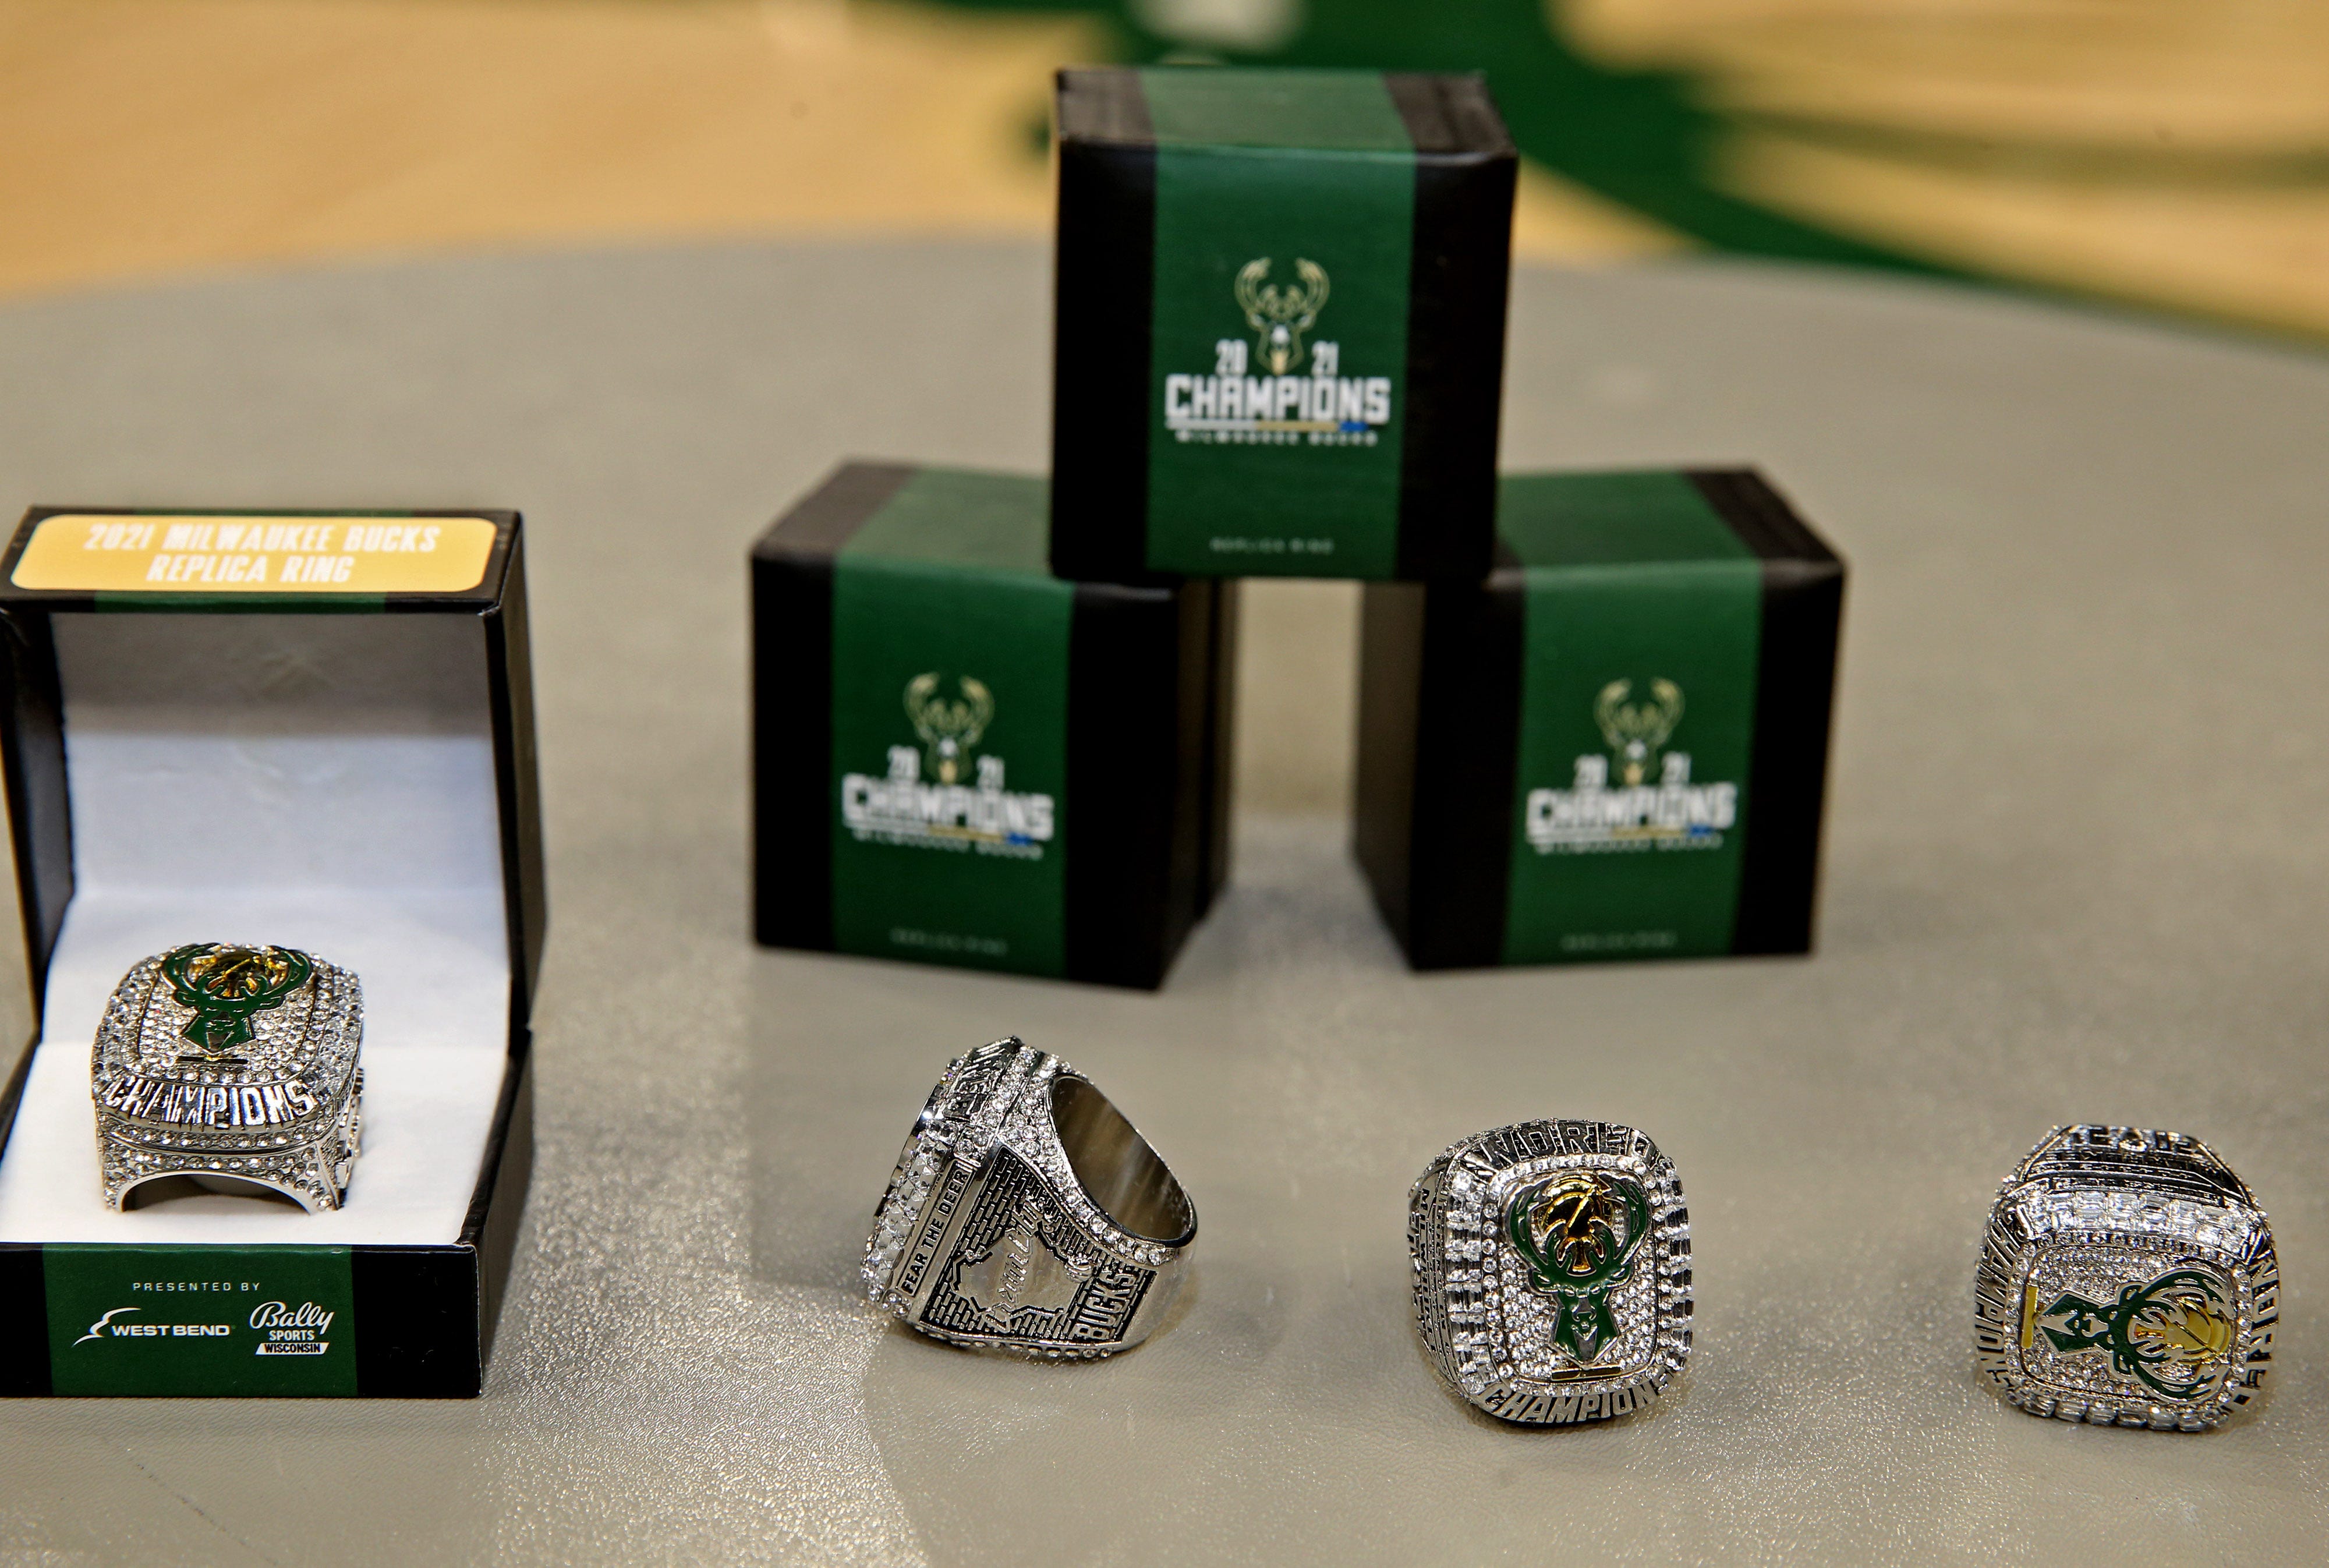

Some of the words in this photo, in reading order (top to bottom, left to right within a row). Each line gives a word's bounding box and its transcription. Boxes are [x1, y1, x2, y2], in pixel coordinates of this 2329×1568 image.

[1216, 339, 1248, 376] 20
[1311, 341, 1339, 376] 21
[1166, 374, 1392, 424] CHAMPIONS
[84, 523, 154, 551] 2021
[162, 525, 331, 551] MILWAUKEE
[342, 526, 441, 552] BUCKS
[146, 555, 266, 582] REPLICA
[280, 556, 355, 583] RING
[104, 1074, 318, 1127] CHAMPIONS
[901, 1252, 929, 1294] FEAR
[921, 1217, 944, 1250] THE
[937, 1169, 969, 1217] DEER
[133, 1282, 232, 1291] PRESENTED
[241, 1282, 260, 1291] BY
[1072, 1268, 1137, 1340] BUCKS
[1976, 1203, 2034, 1389] CHAMPIONS
[112, 1325, 170, 1336] WEST
[173, 1325, 230, 1336] BEND
[249, 1301, 335, 1335] Bally
[268, 1330, 315, 1341] SPORTS
[264, 1343, 321, 1353] WISCONSIN
[1477, 1368, 1670, 1423] CHAMPIONS
